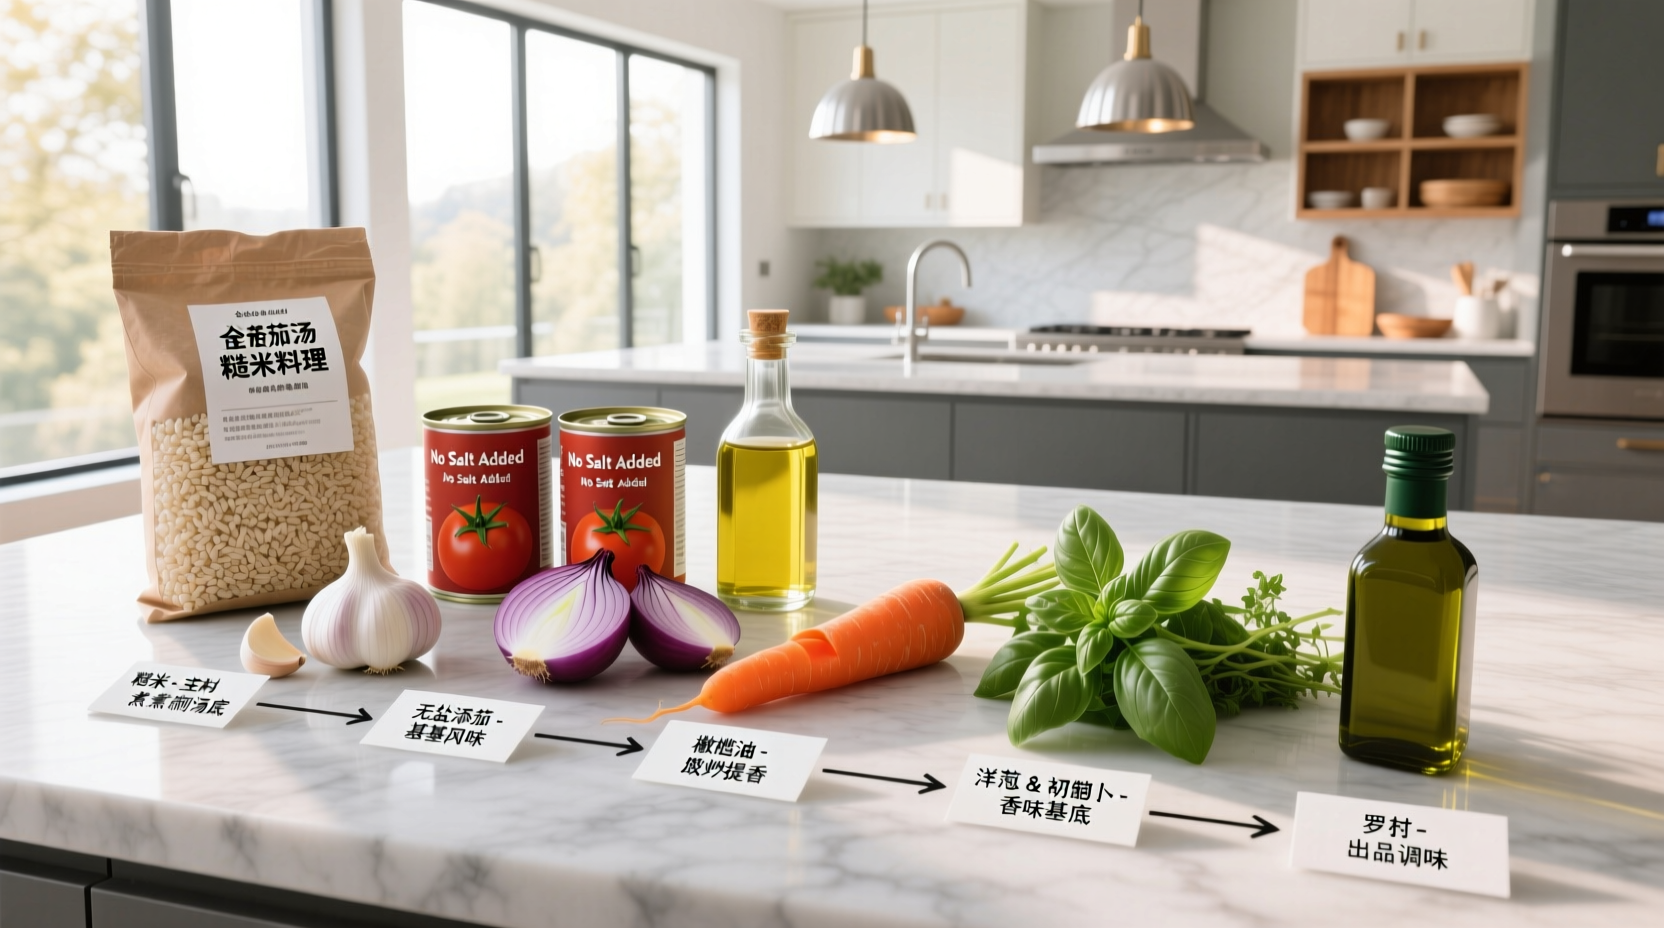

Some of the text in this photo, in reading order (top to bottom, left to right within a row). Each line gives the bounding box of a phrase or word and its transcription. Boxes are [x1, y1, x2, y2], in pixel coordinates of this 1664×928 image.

[219, 347, 329, 380] 糙米料理
[430, 449, 524, 466] No Salt Added
[568, 452, 661, 470] No Salt Added
[457, 473, 477, 485] Salt
[999, 795, 1092, 826] 香味基底
[1347, 838, 1448, 871] 出品调味
